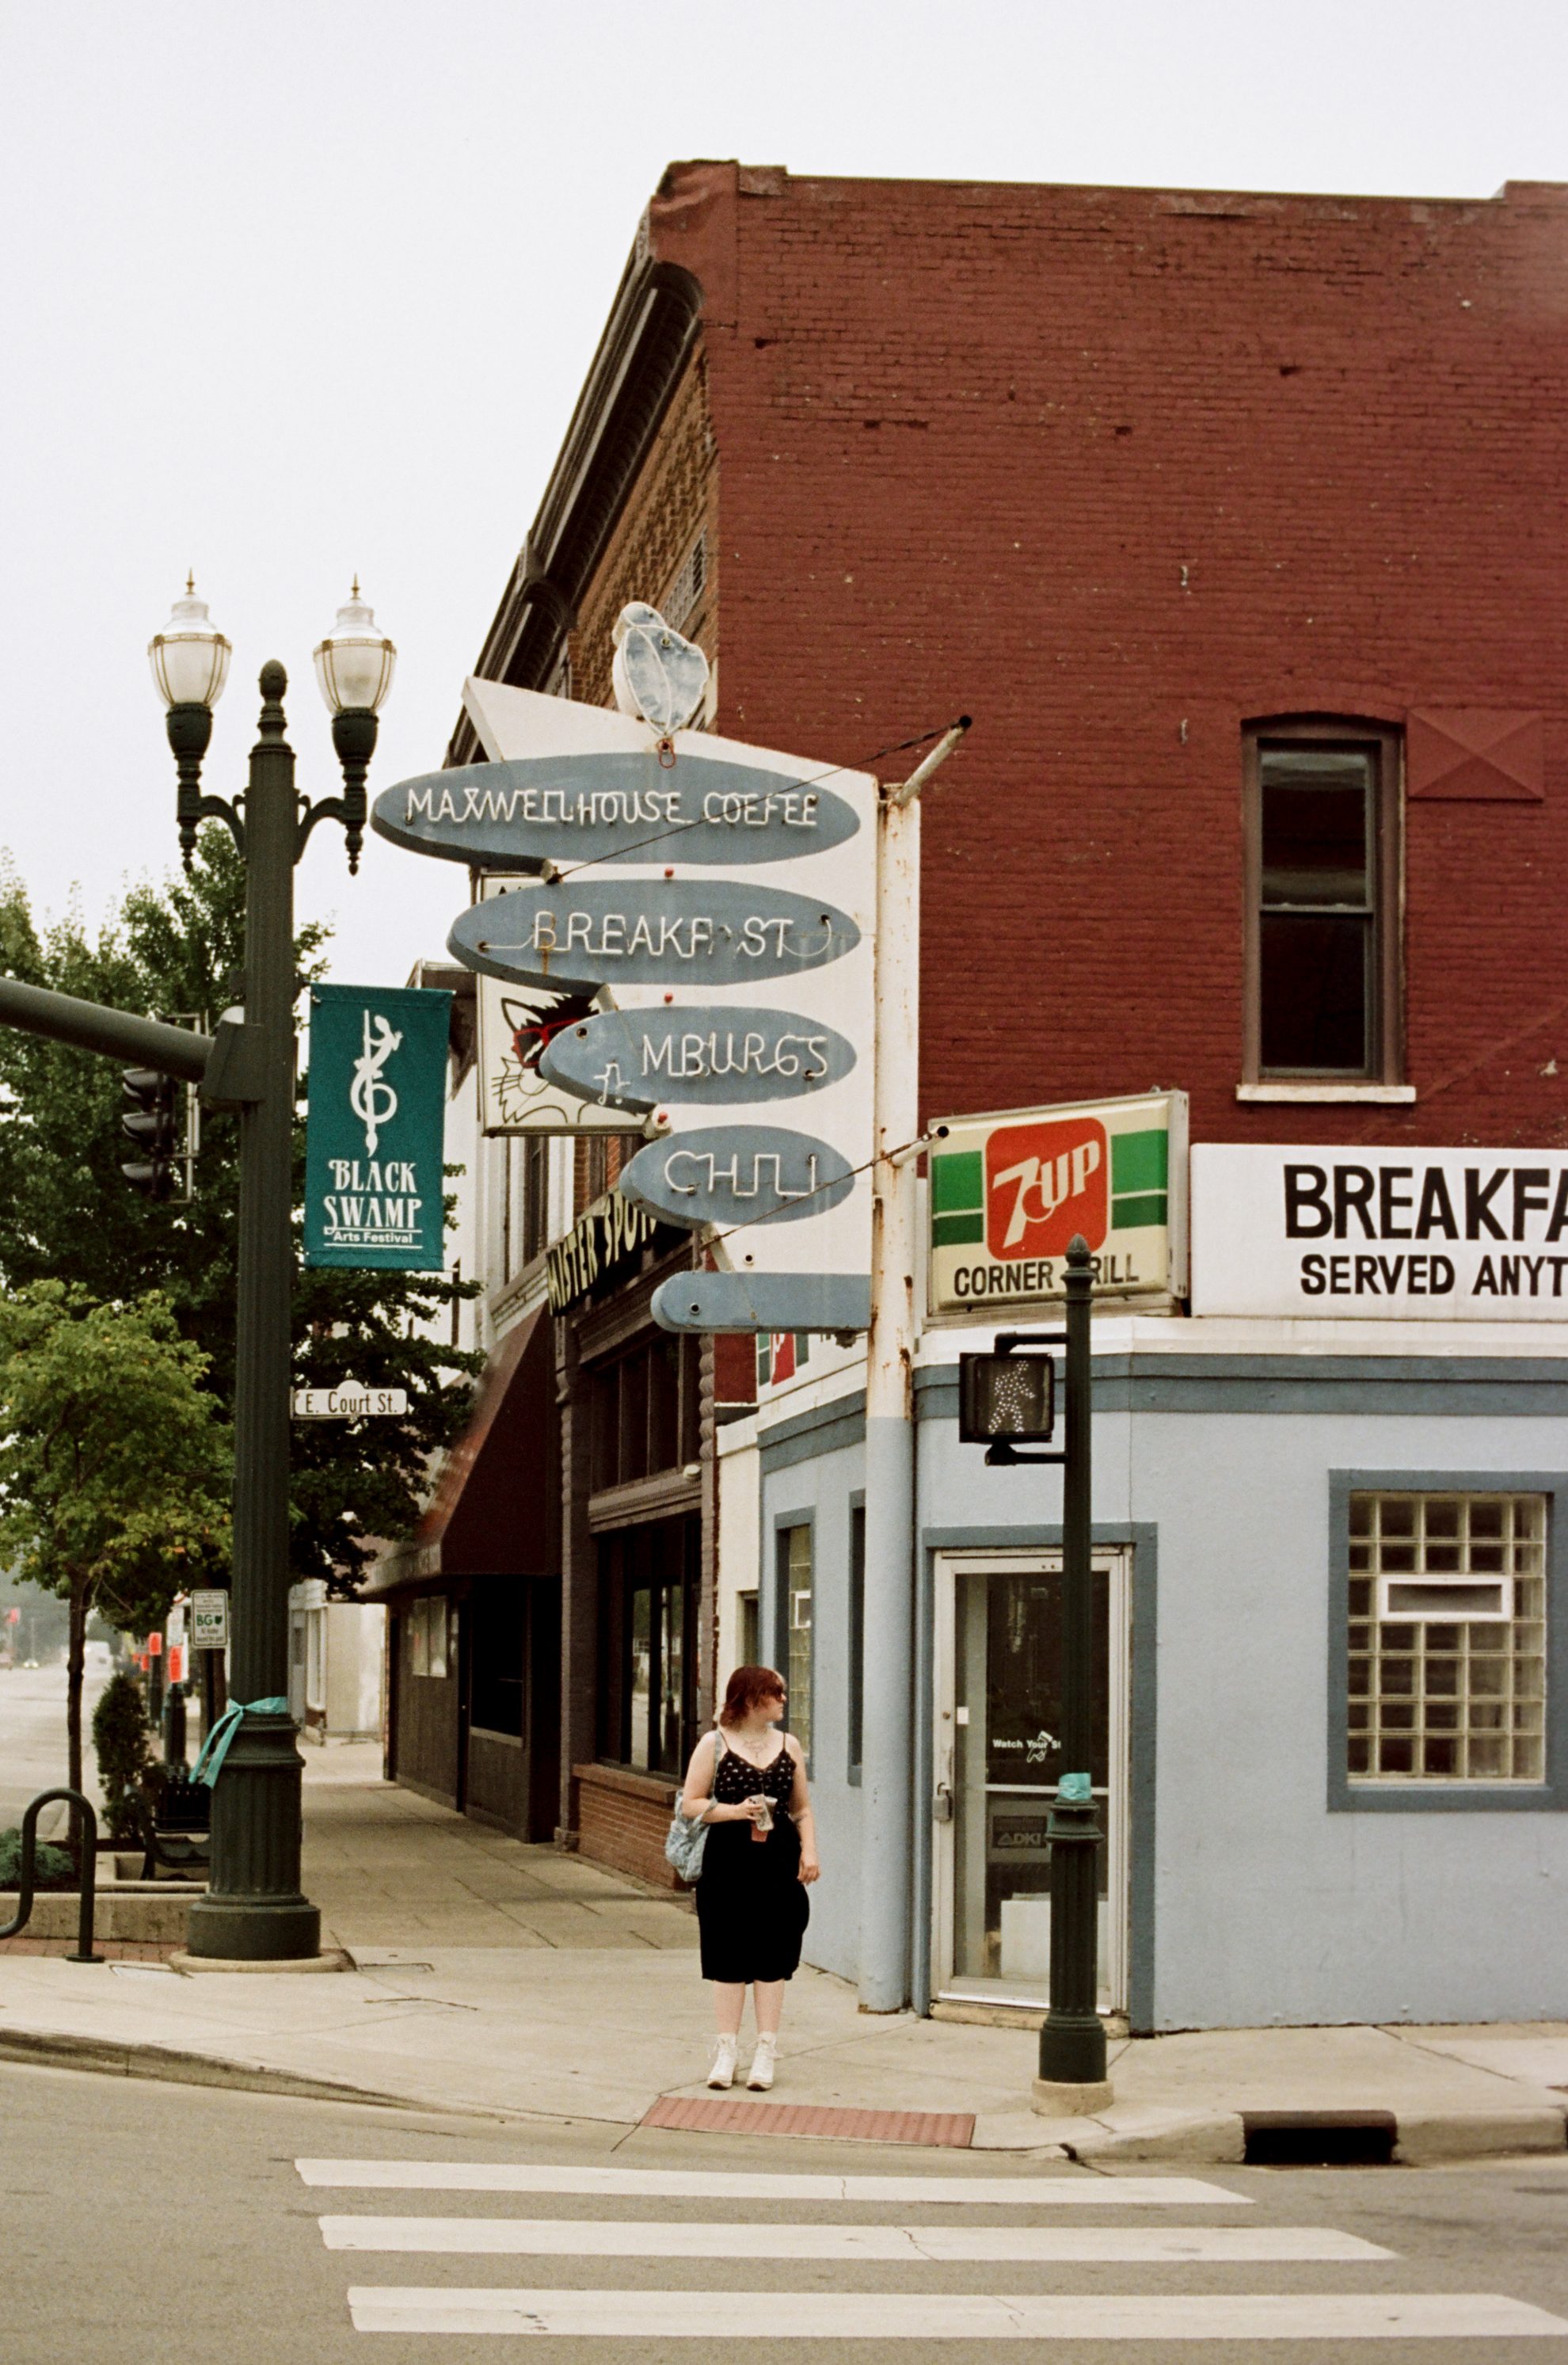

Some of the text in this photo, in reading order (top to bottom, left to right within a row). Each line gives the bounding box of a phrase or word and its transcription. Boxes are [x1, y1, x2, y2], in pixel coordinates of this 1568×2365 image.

[328, 1159, 418, 1194] BLACK
[991, 1140, 1101, 1250] 7UP
[323, 1194, 423, 1236] SWAMP
[333, 1230, 413, 1244] Arts Festival
[953, 1253, 1140, 1297] CORNER RILL
[1300, 1253, 1568, 1298] SERVED ANYT
[305, 1390, 398, 1414] E. Court St.
[196, 1613, 214, 1627] BG
[992, 1739, 1024, 1749] Watch
[1026, 1739, 1049, 1749] Your
